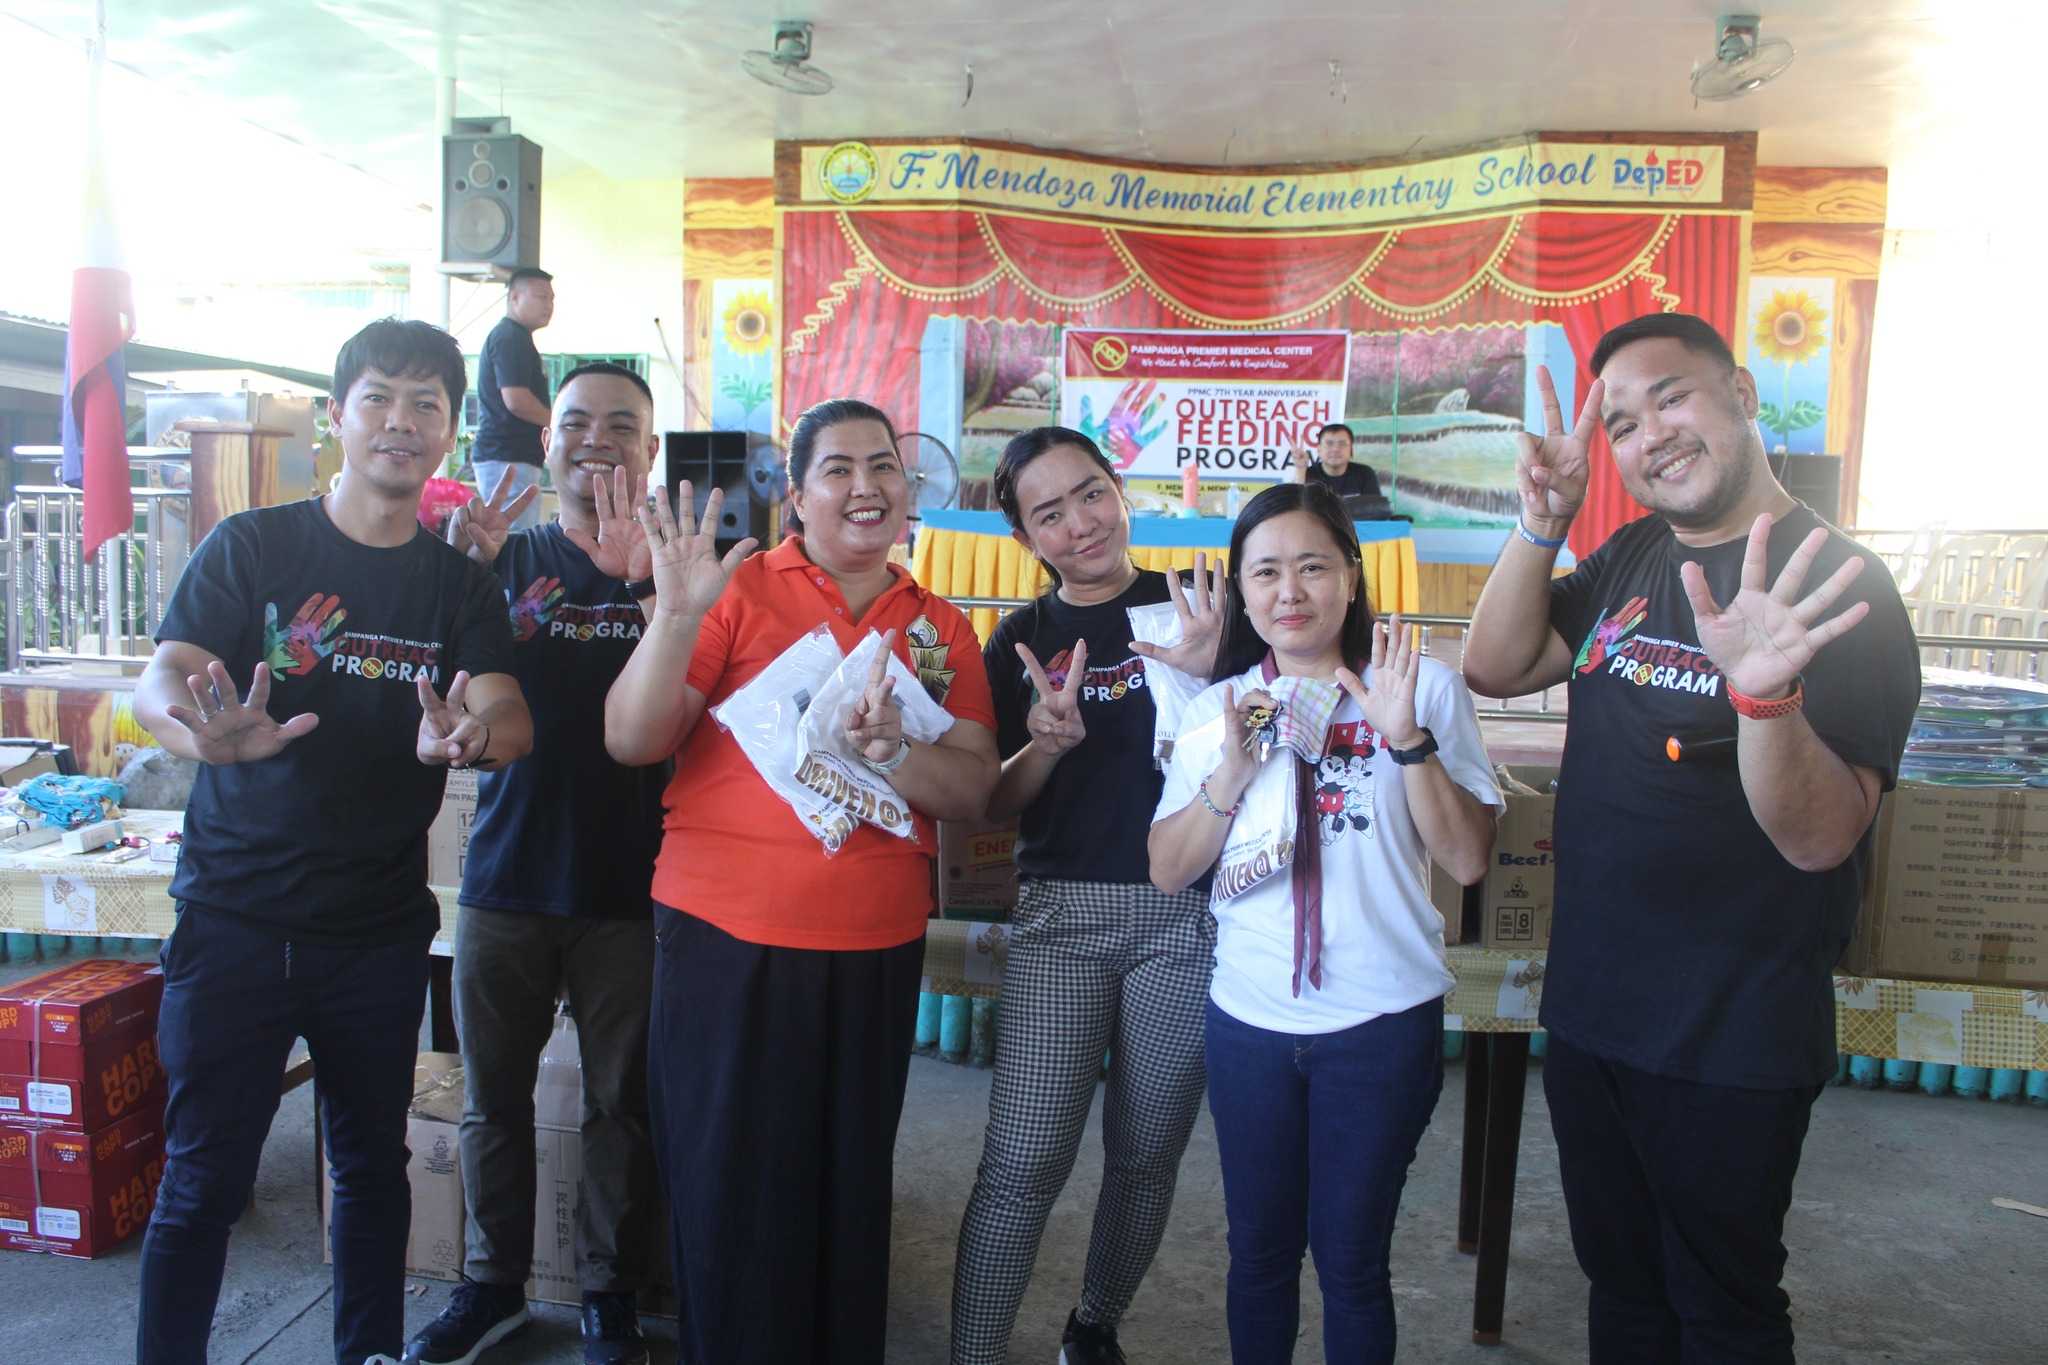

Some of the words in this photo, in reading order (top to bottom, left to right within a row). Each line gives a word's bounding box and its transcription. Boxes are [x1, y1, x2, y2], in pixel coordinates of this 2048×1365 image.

[889, 151, 938, 190] F.
[936, 153, 1096, 208] Mendoza
[1098, 173, 1255, 214] Memorial
[1262, 172, 1454, 217] Elementary
[1473, 152, 1597, 197] School
[1614, 158, 1703, 196] DepED
[1130, 344, 1184, 355] PAMPANGA
[1186, 346, 1228, 356] PREMIER
[1229, 346, 1272, 356] MEDICAL
[1274, 346, 1313, 356] CENTER
[1188, 388, 1213, 396] PPMC
[1215, 388, 1231, 397] 7TH
[1233, 389, 1255, 397] YEAR
[1257, 389, 1320, 398] ANNIVERSARY
[1176, 398, 1330, 422] OUTREACH
[1176, 419, 1322, 448] FEEDING
[1176, 447, 1323, 472] PROGRA
[550, 620, 647, 641] PROGRA
[334, 634, 438, 665] OUTREAC
[1620, 638, 1723, 676] OUTREAC
[1081, 658, 1145, 687] OUTRE
[1608, 654, 1719, 698] PROGRAM
[1083, 673, 1143, 702] PROG
[1498, 852, 1548, 867] Beef
[1519, 912, 1529, 929] 8
[102, 1039, 157, 1097] HAR
[106, 1061, 165, 1117] COP
[111, 1157, 163, 1219] HAR
